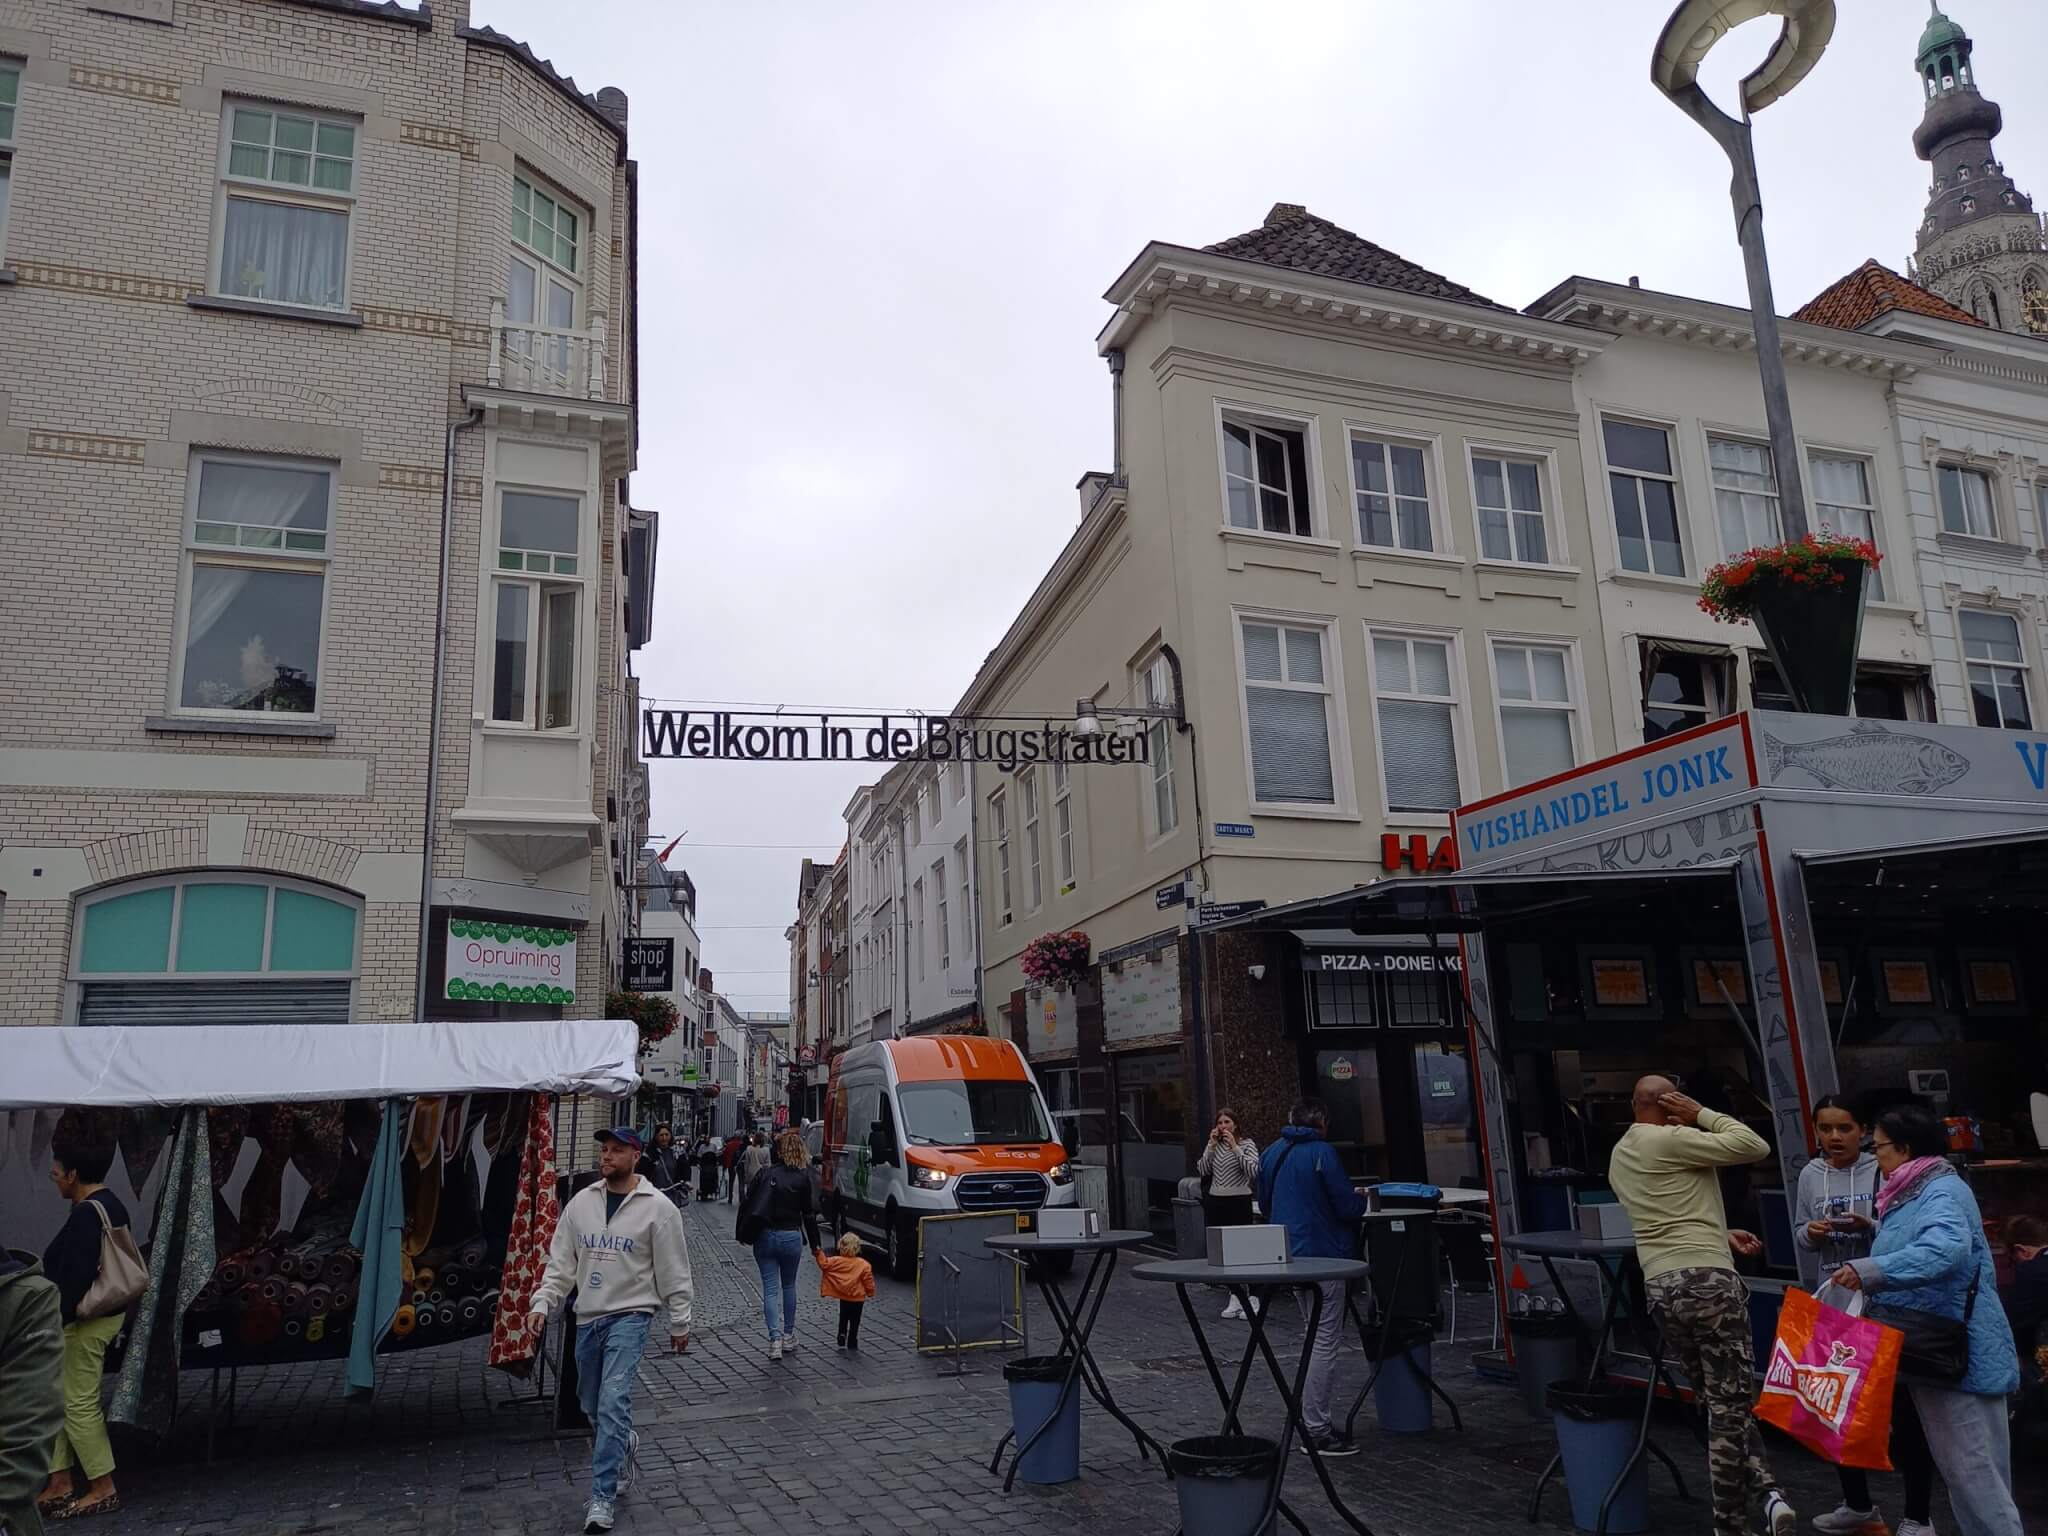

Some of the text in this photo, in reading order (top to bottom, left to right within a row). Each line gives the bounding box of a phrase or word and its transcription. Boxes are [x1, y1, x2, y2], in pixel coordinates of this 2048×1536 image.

[647, 711, 1148, 772] Welkom in de Brugstraten
[1467, 746, 1734, 852] VISHANDEL JONK
[466, 942, 561, 976] Opruiming
[631, 944, 665, 968] shop
[1320, 955, 1372, 970] PIZZA
[577, 1233, 634, 1253] PALMER
[1770, 1356, 1793, 1386] BIG
[1796, 1373, 1840, 1415] BAZAR
